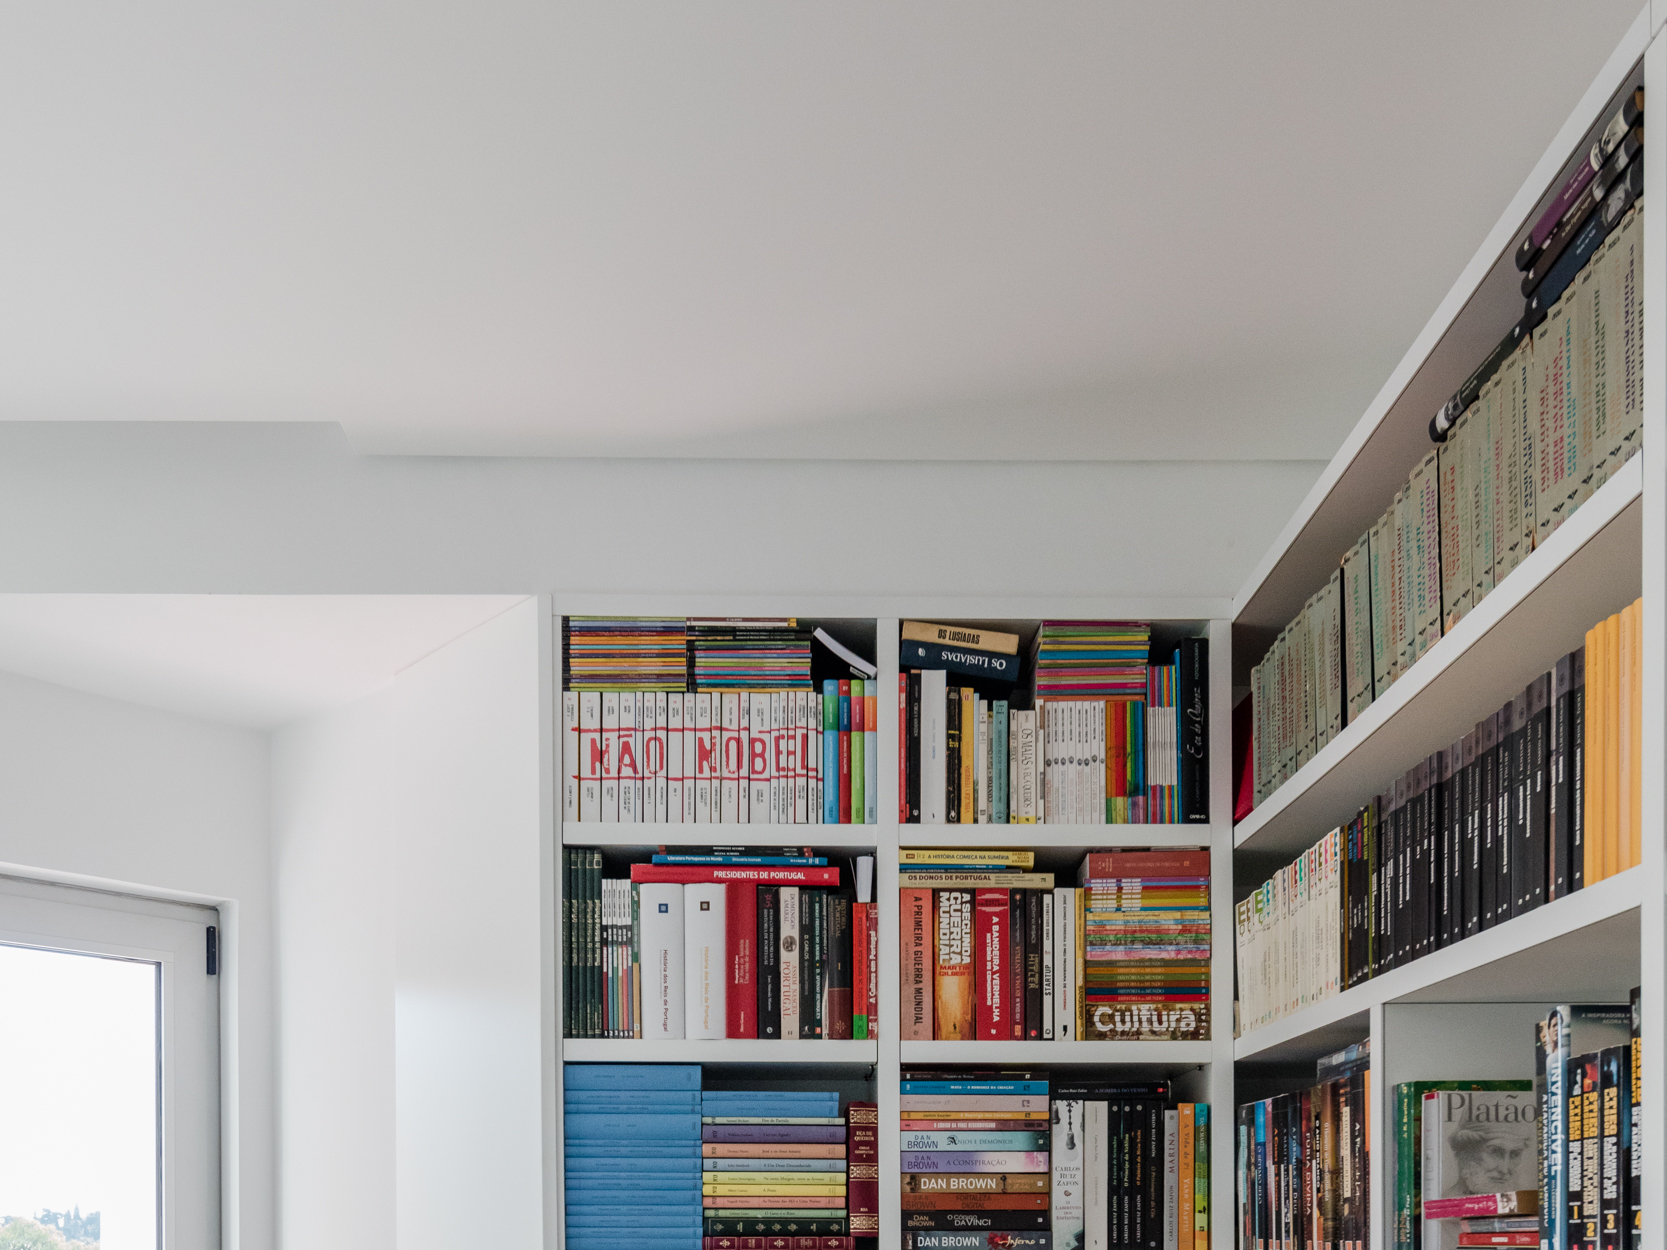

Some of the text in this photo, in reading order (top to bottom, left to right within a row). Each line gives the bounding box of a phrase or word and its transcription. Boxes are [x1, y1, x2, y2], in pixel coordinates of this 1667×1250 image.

[938, 628, 980, 645] OS LUSÍADAS
[590, 733, 819, 776] NÃO NOBEL
[1022, 728, 1033, 766] OS MAIAS
[914, 905, 922, 948] PRIMEIRA
[940, 892, 950, 965] MUNDIAL
[950, 892, 962, 965] GUERRA
[962, 893, 970, 965] A SEGUNDA
[992, 916, 999, 924] A
[914, 950, 922, 984] GUERRA
[782, 961, 790, 1020] PORTUGAL
[914, 988, 922, 1026] MUNDIAL
[1094, 1004, 1196, 1031] Cultura
[1444, 1092, 1538, 1123] Platão
[1551, 1062, 1565, 1176] INVENCÍVEL
[1589, 1090, 1598, 1138] STIEG
[908, 1141, 938, 1149] BROWN
[908, 1161, 938, 1169] BROWN
[920, 1178, 947, 1189] DAN
[950, 1178, 996, 1189] BROWN
[918, 1235, 1036, 1247] DAN BROWN Inferno
